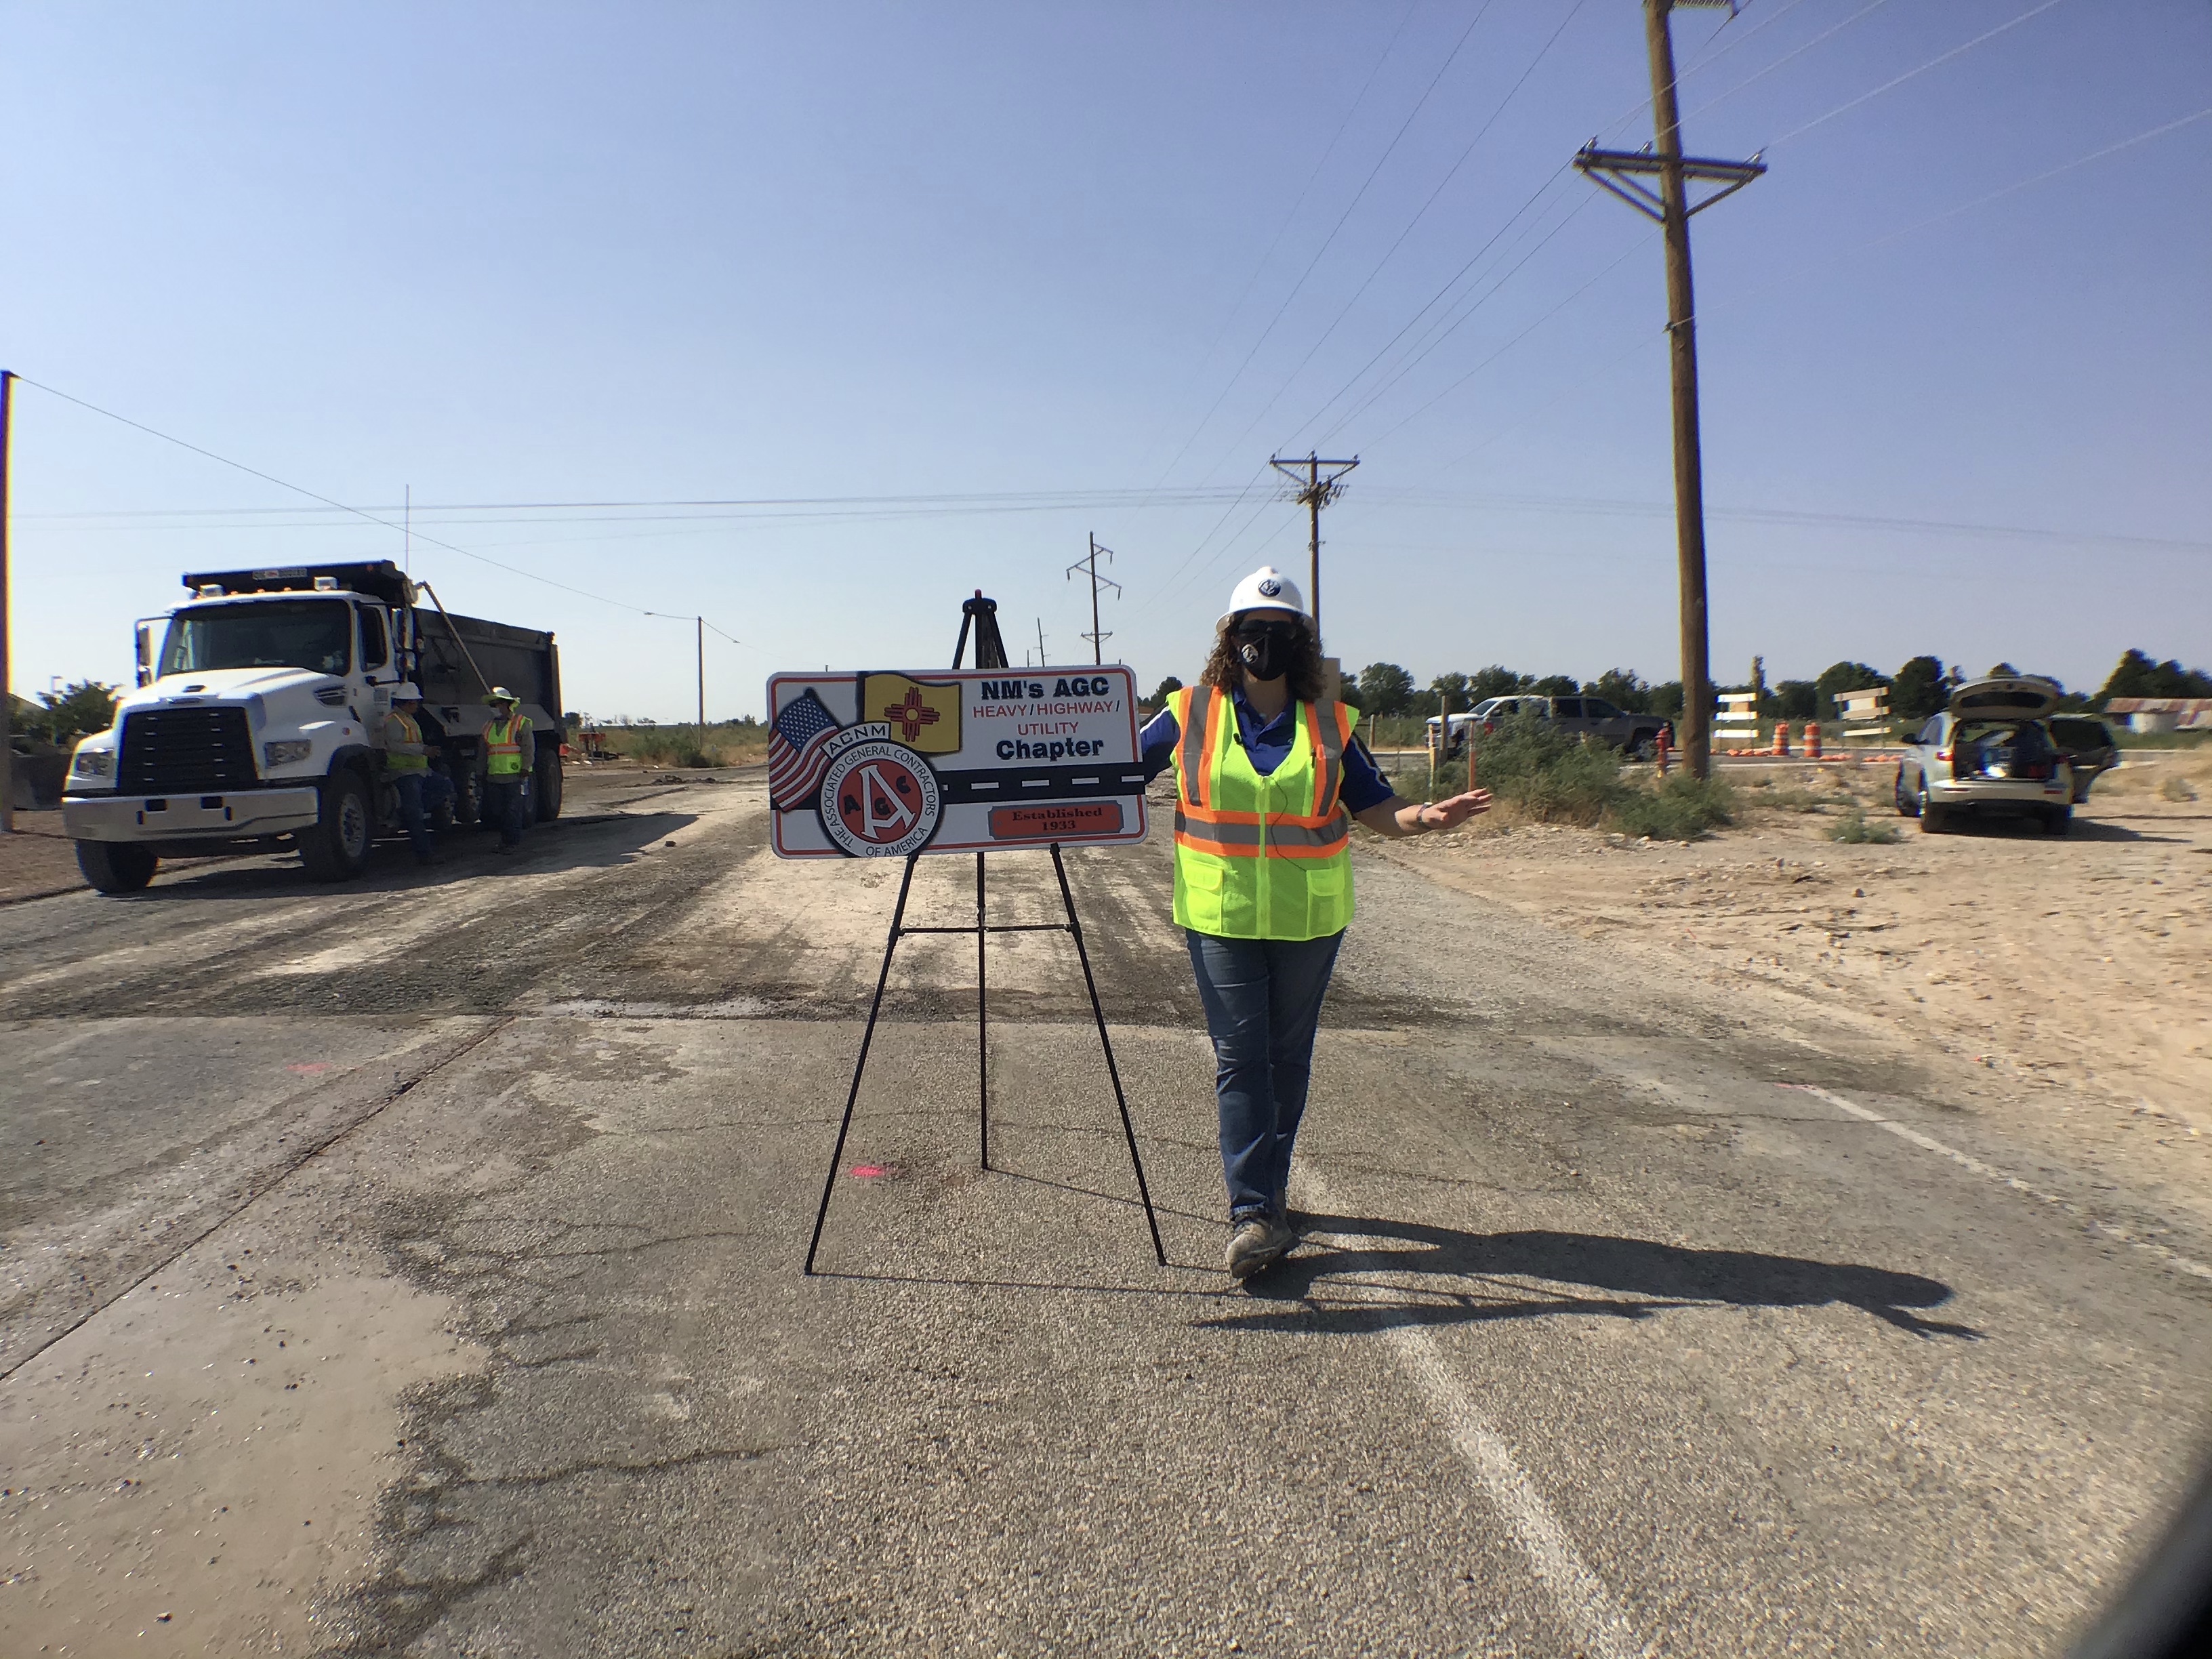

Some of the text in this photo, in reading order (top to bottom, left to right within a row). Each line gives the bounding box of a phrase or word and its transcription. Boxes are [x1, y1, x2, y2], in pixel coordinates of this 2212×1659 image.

[981, 677, 1109, 700] NM's AGC
[1017, 721, 1079, 736] UTILITY
[996, 737, 1104, 762] Chapter
[824, 745, 937, 848] THE ASSOCIATED GENERAL CONTRACTORS
[1012, 807, 1102, 821] Established
[1042, 820, 1076, 831] 1933
[865, 827, 928, 857] OF AMERICA
